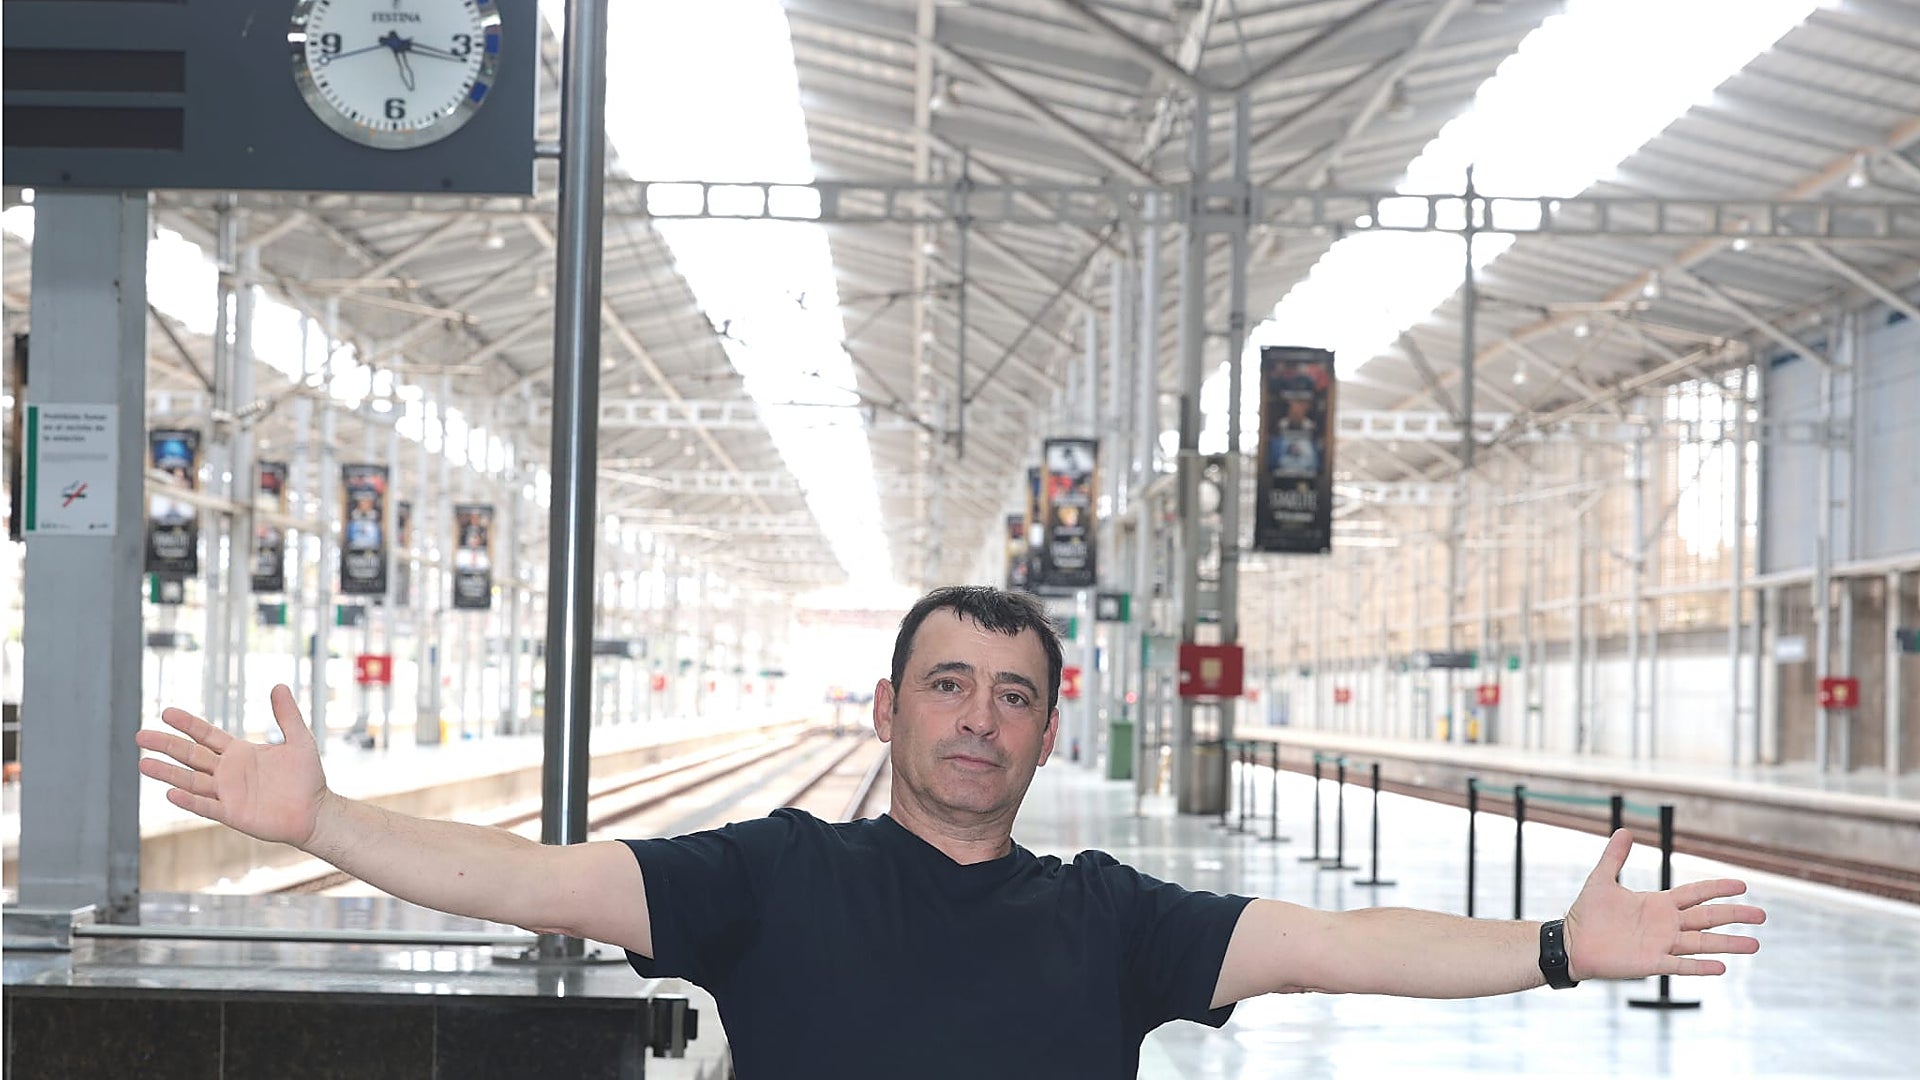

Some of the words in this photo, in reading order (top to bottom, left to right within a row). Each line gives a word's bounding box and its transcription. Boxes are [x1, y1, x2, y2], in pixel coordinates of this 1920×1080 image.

[372, 12, 422, 23] FESTINA
[321, 33, 341, 54] 9
[451, 34, 471, 56] 3
[384, 98, 405, 119] 6
